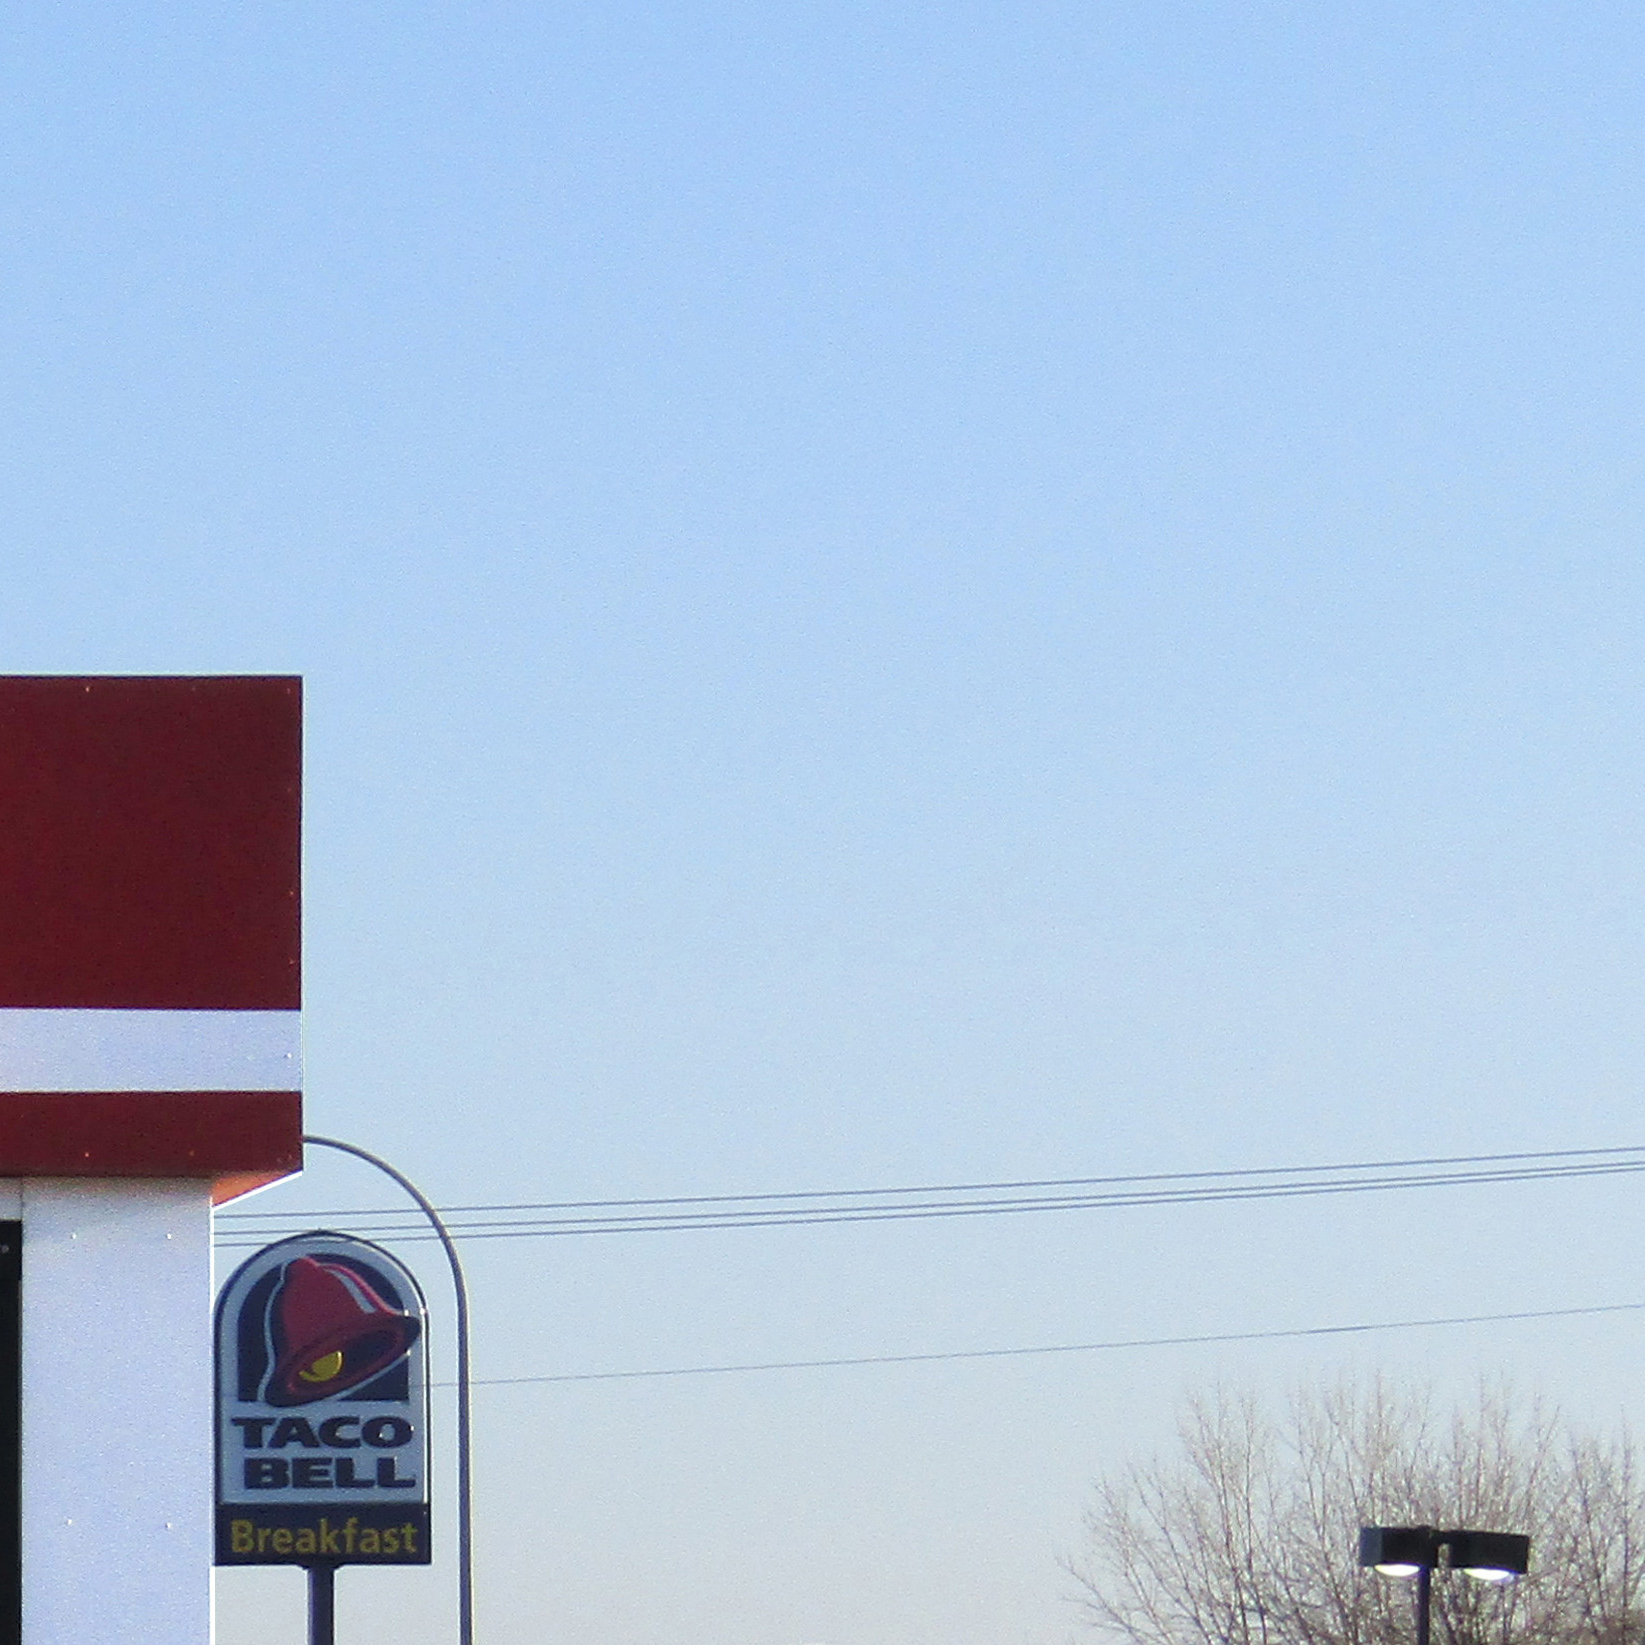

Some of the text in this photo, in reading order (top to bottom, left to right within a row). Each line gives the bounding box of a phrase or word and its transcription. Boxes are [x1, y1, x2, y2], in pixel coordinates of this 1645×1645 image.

[231, 1415, 415, 1450] TACO
[243, 1456, 417, 1490] BELL
[230, 1517, 419, 1555] Breakfast
